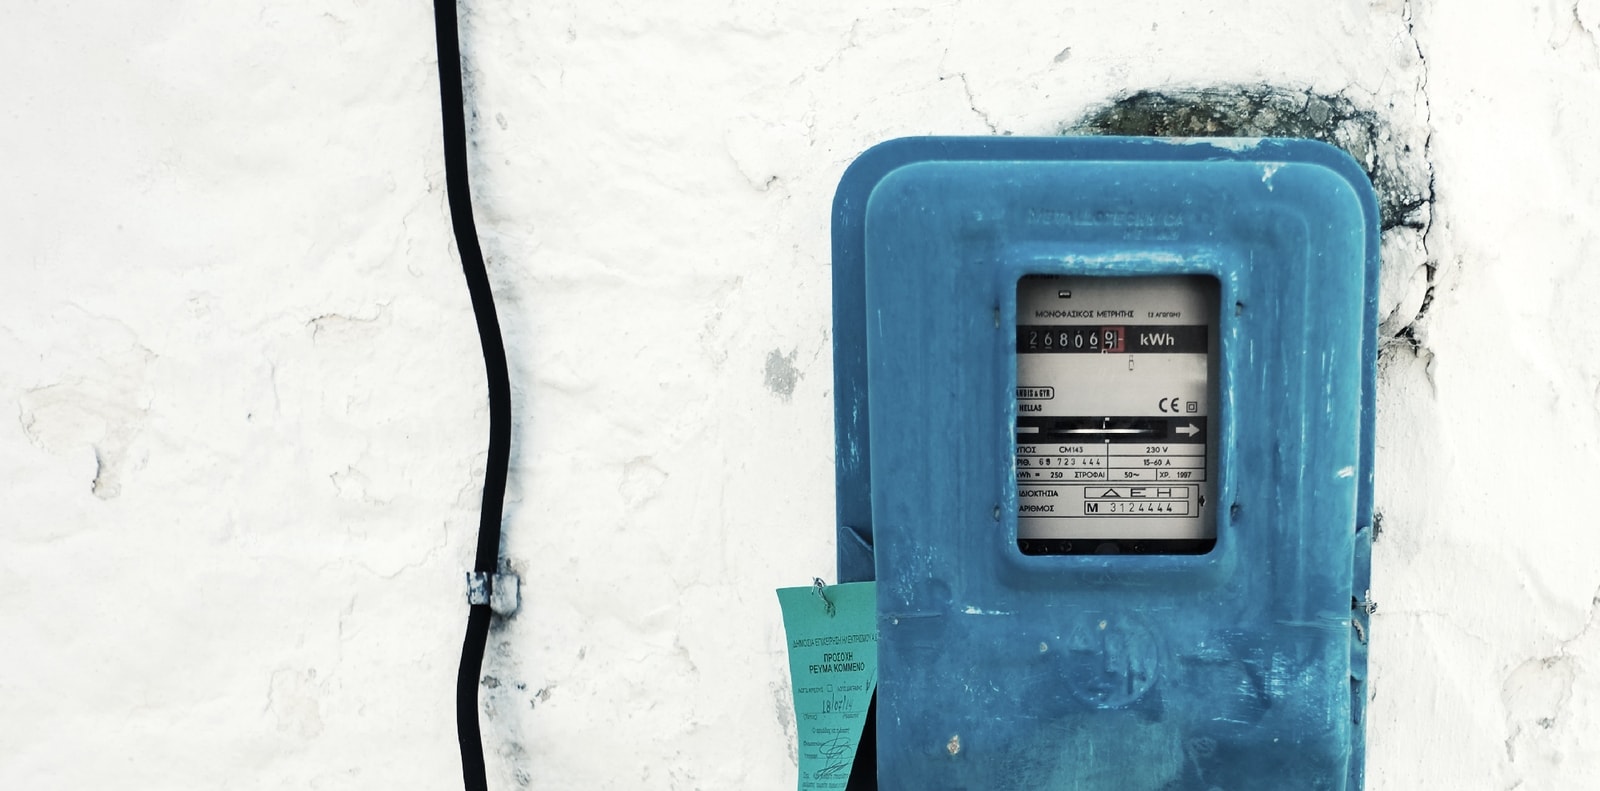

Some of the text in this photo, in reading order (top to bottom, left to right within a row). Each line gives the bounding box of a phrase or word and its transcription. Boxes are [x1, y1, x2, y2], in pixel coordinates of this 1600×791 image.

[1035, 310, 1094, 318] ΜΟΝΟΦΑΣΙΚΟΣ
[1096, 310, 1134, 318] ΜΕΤΡΗΤΗΣ
[1140, 333, 1175, 346] kWh
[1019, 489, 1059, 497] ΙΔΙΟΚΤΗΣΙΑ
[1101, 488, 1172, 498] ΔΕΗ
[1019, 504, 1055, 512] ΑΡΙΘΜΟΣ
[1087, 502, 1173, 513] M 3124444
[823, 651, 854, 663] ΠΡΟΣΟΧΗ
[808, 662, 866, 674] ΡΕΥΜΑ ΚΟΜΜΕΝΟ
